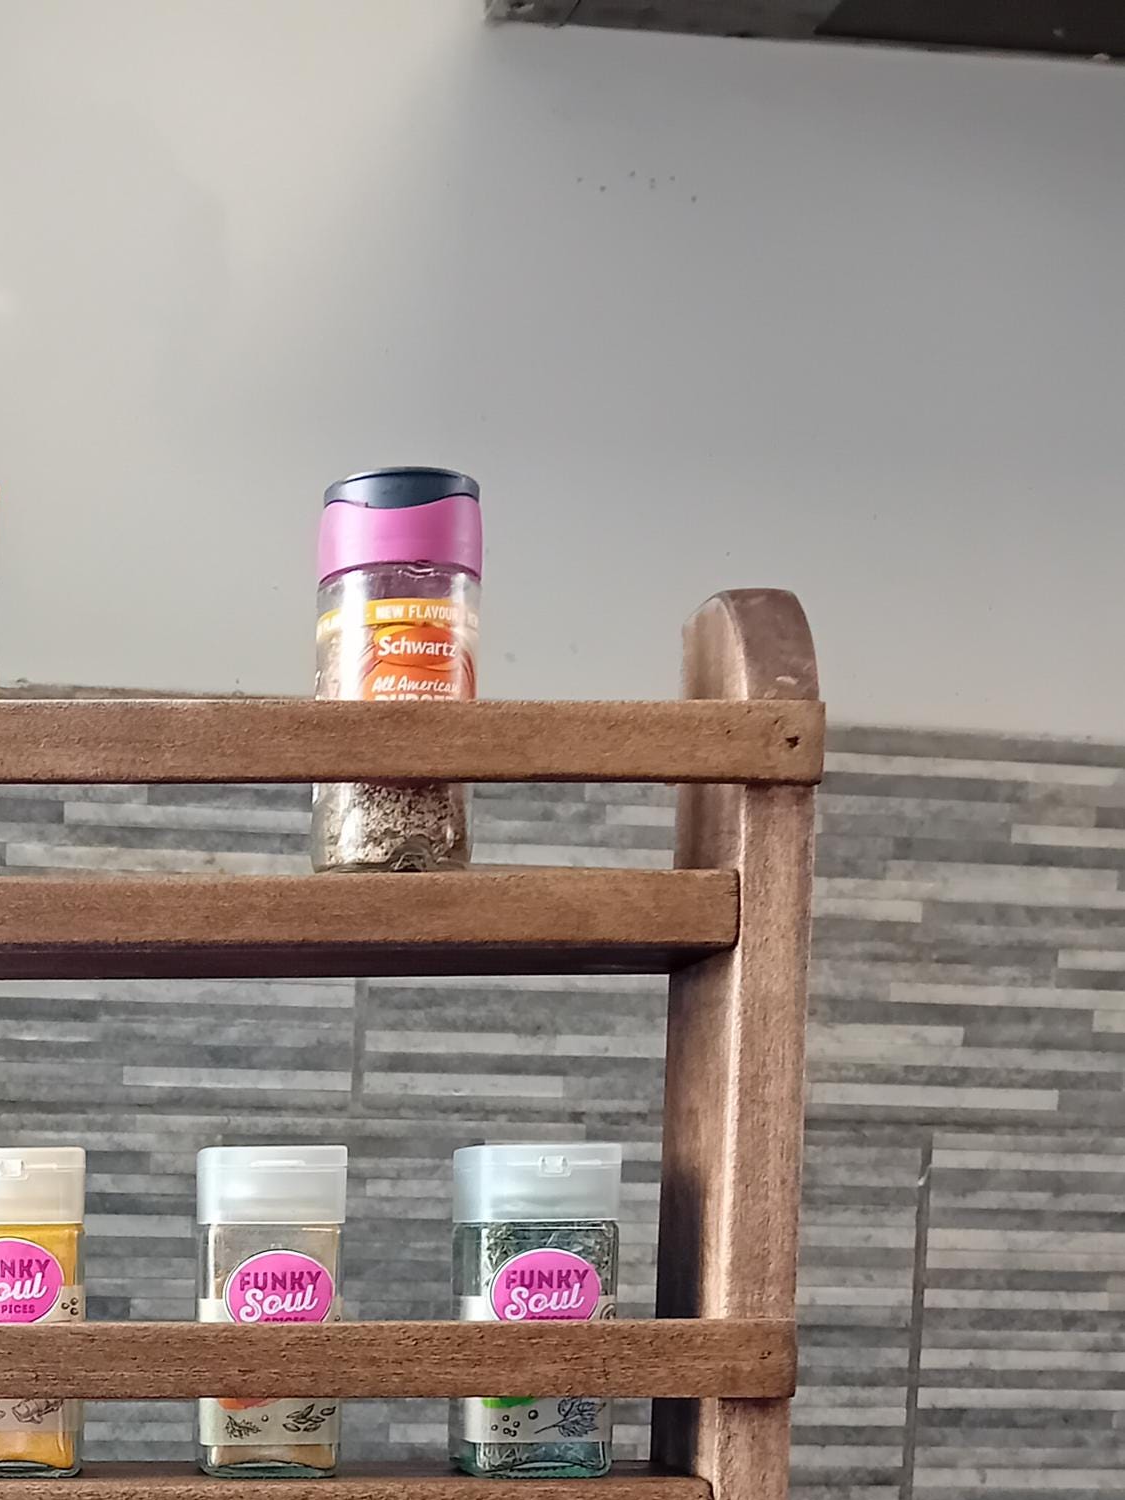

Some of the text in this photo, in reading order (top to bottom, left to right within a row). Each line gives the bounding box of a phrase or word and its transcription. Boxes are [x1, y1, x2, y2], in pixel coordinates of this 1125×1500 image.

[376, 605, 404, 619] NEW
[377, 636, 457, 657] Schwartz
[371, 677, 396, 693] All
[239, 1271, 322, 1291] FUNKY
[505, 1269, 590, 1289] FUNKY
[239, 1284, 318, 1322] Soul
[504, 1282, 585, 1320] Soul
